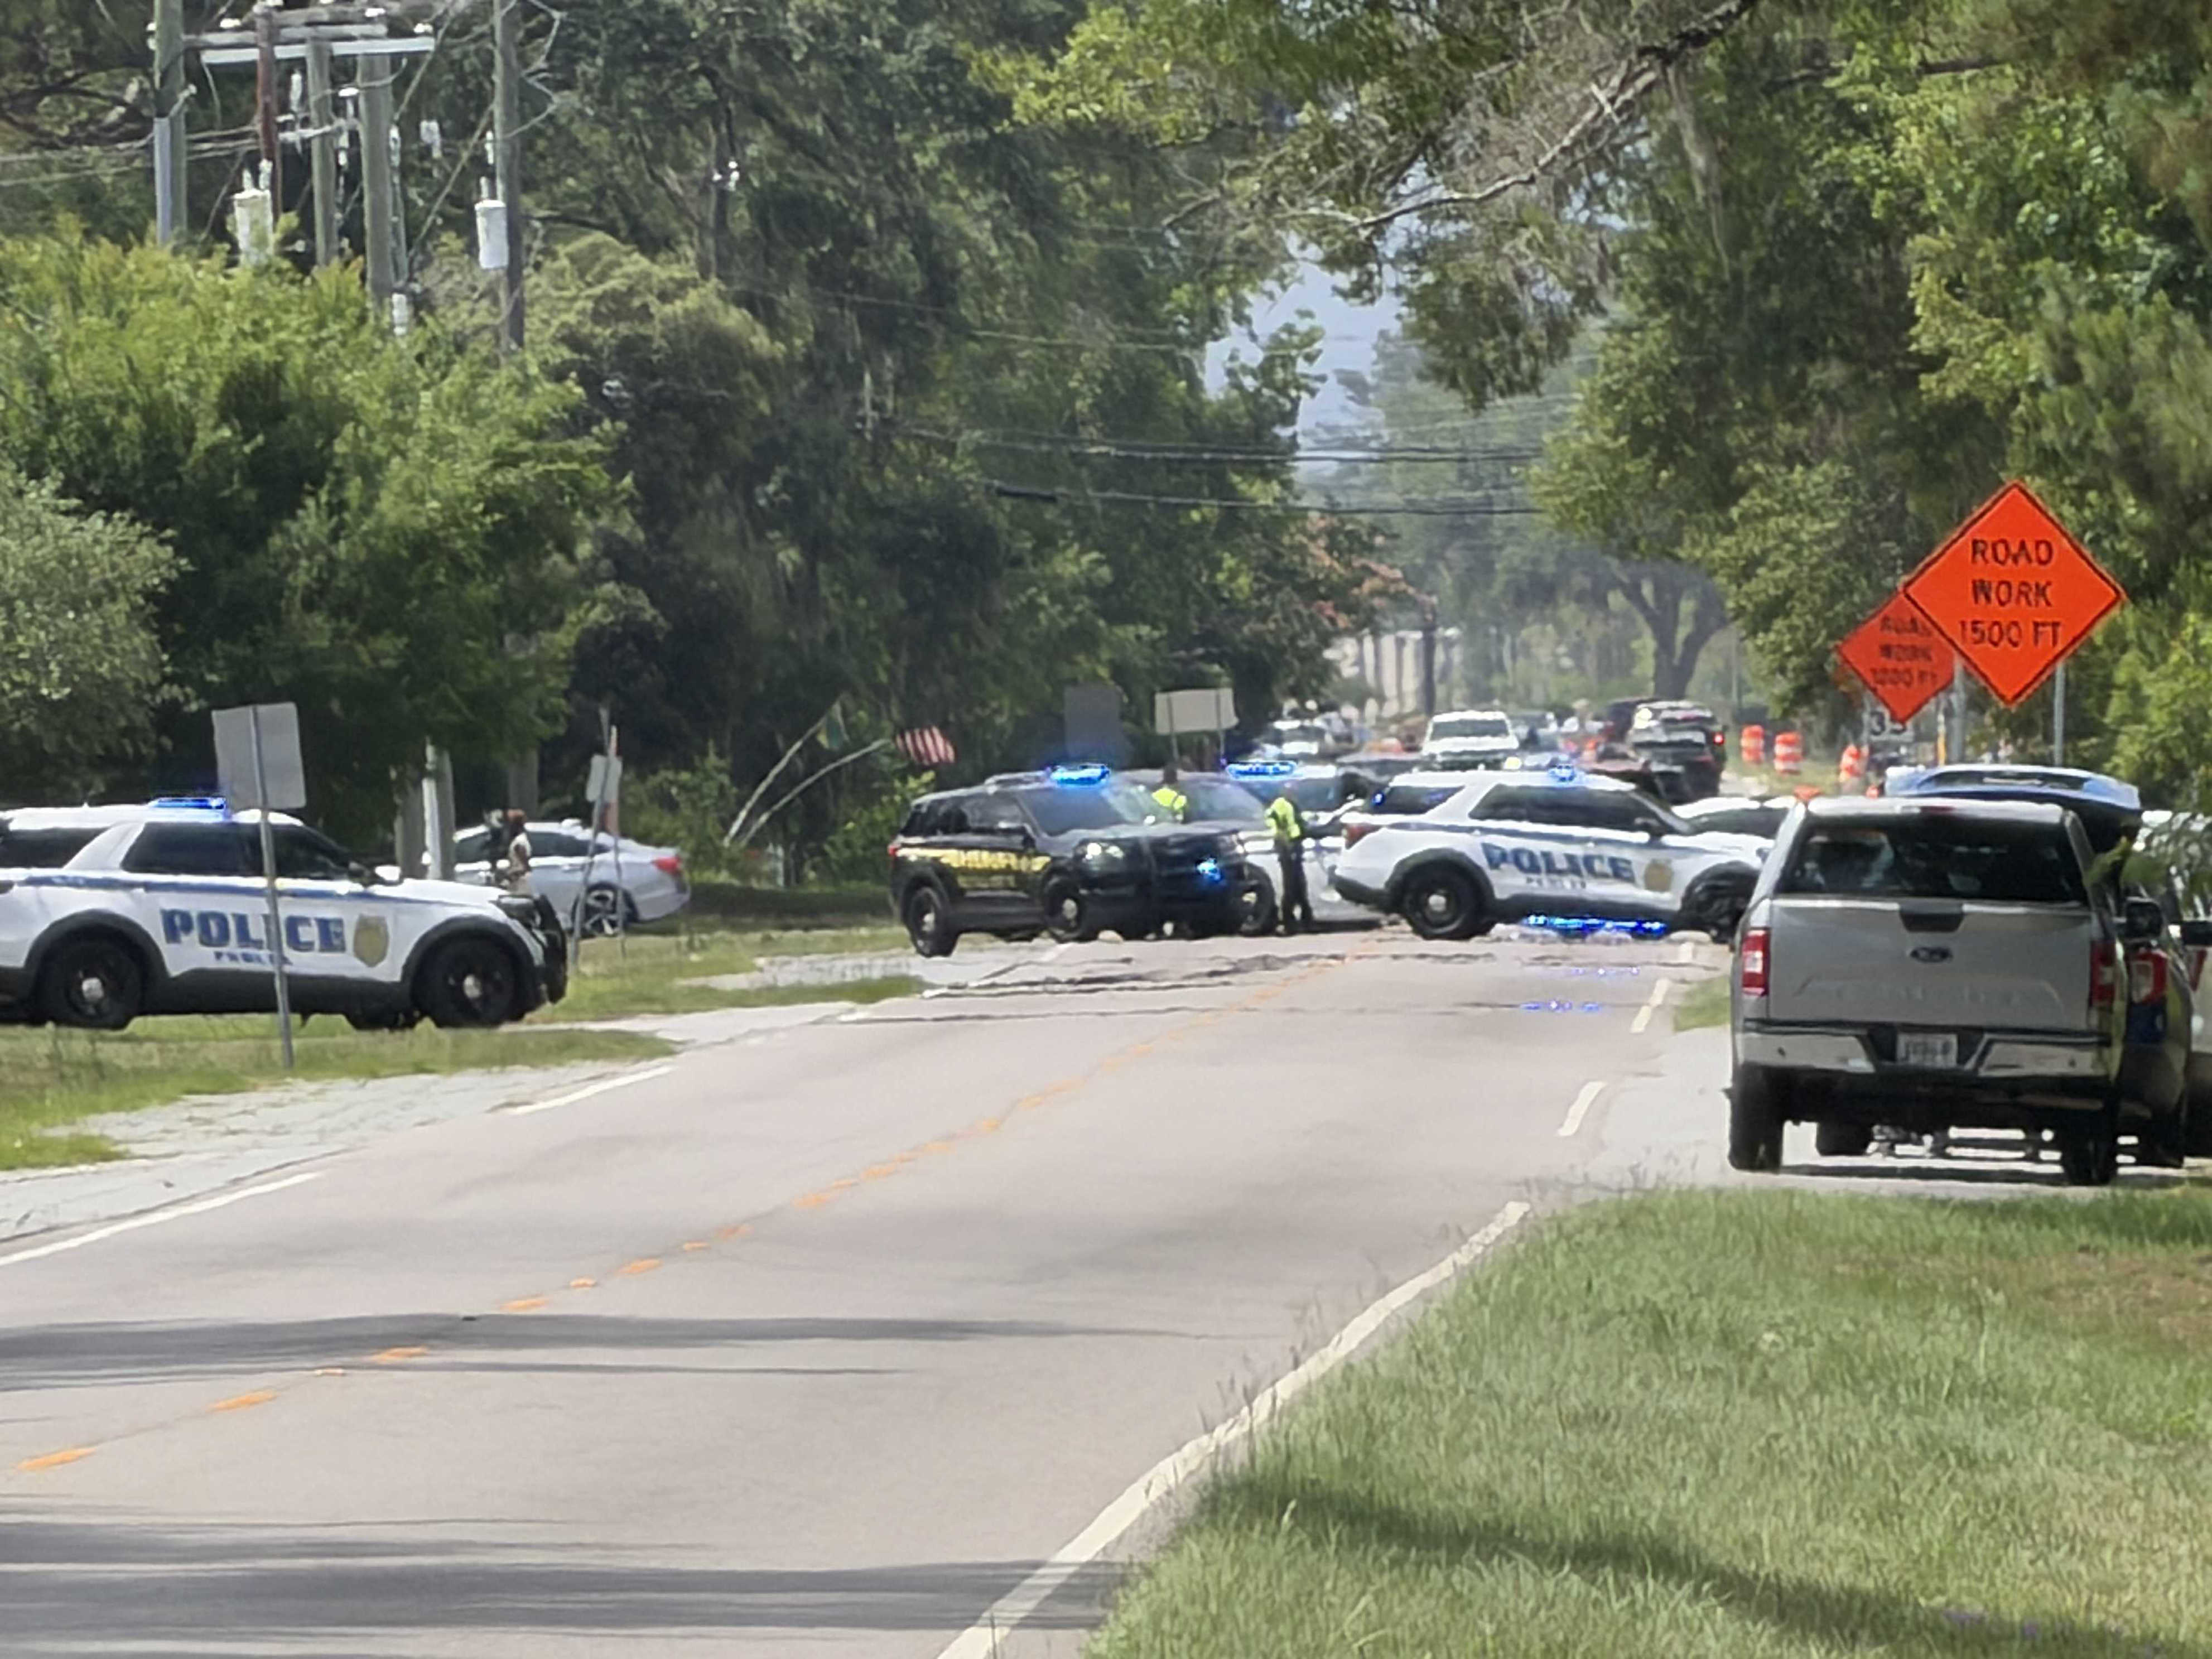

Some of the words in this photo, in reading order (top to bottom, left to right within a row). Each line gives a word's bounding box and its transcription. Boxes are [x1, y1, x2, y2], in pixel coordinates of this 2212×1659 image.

[1971, 538, 2053, 566] ROAD
[1971, 578, 2052, 607] WORK
[1959, 620, 2022, 648] 1500
[2032, 621, 2061, 647] FT
[1481, 842, 1636, 885] POLICE
